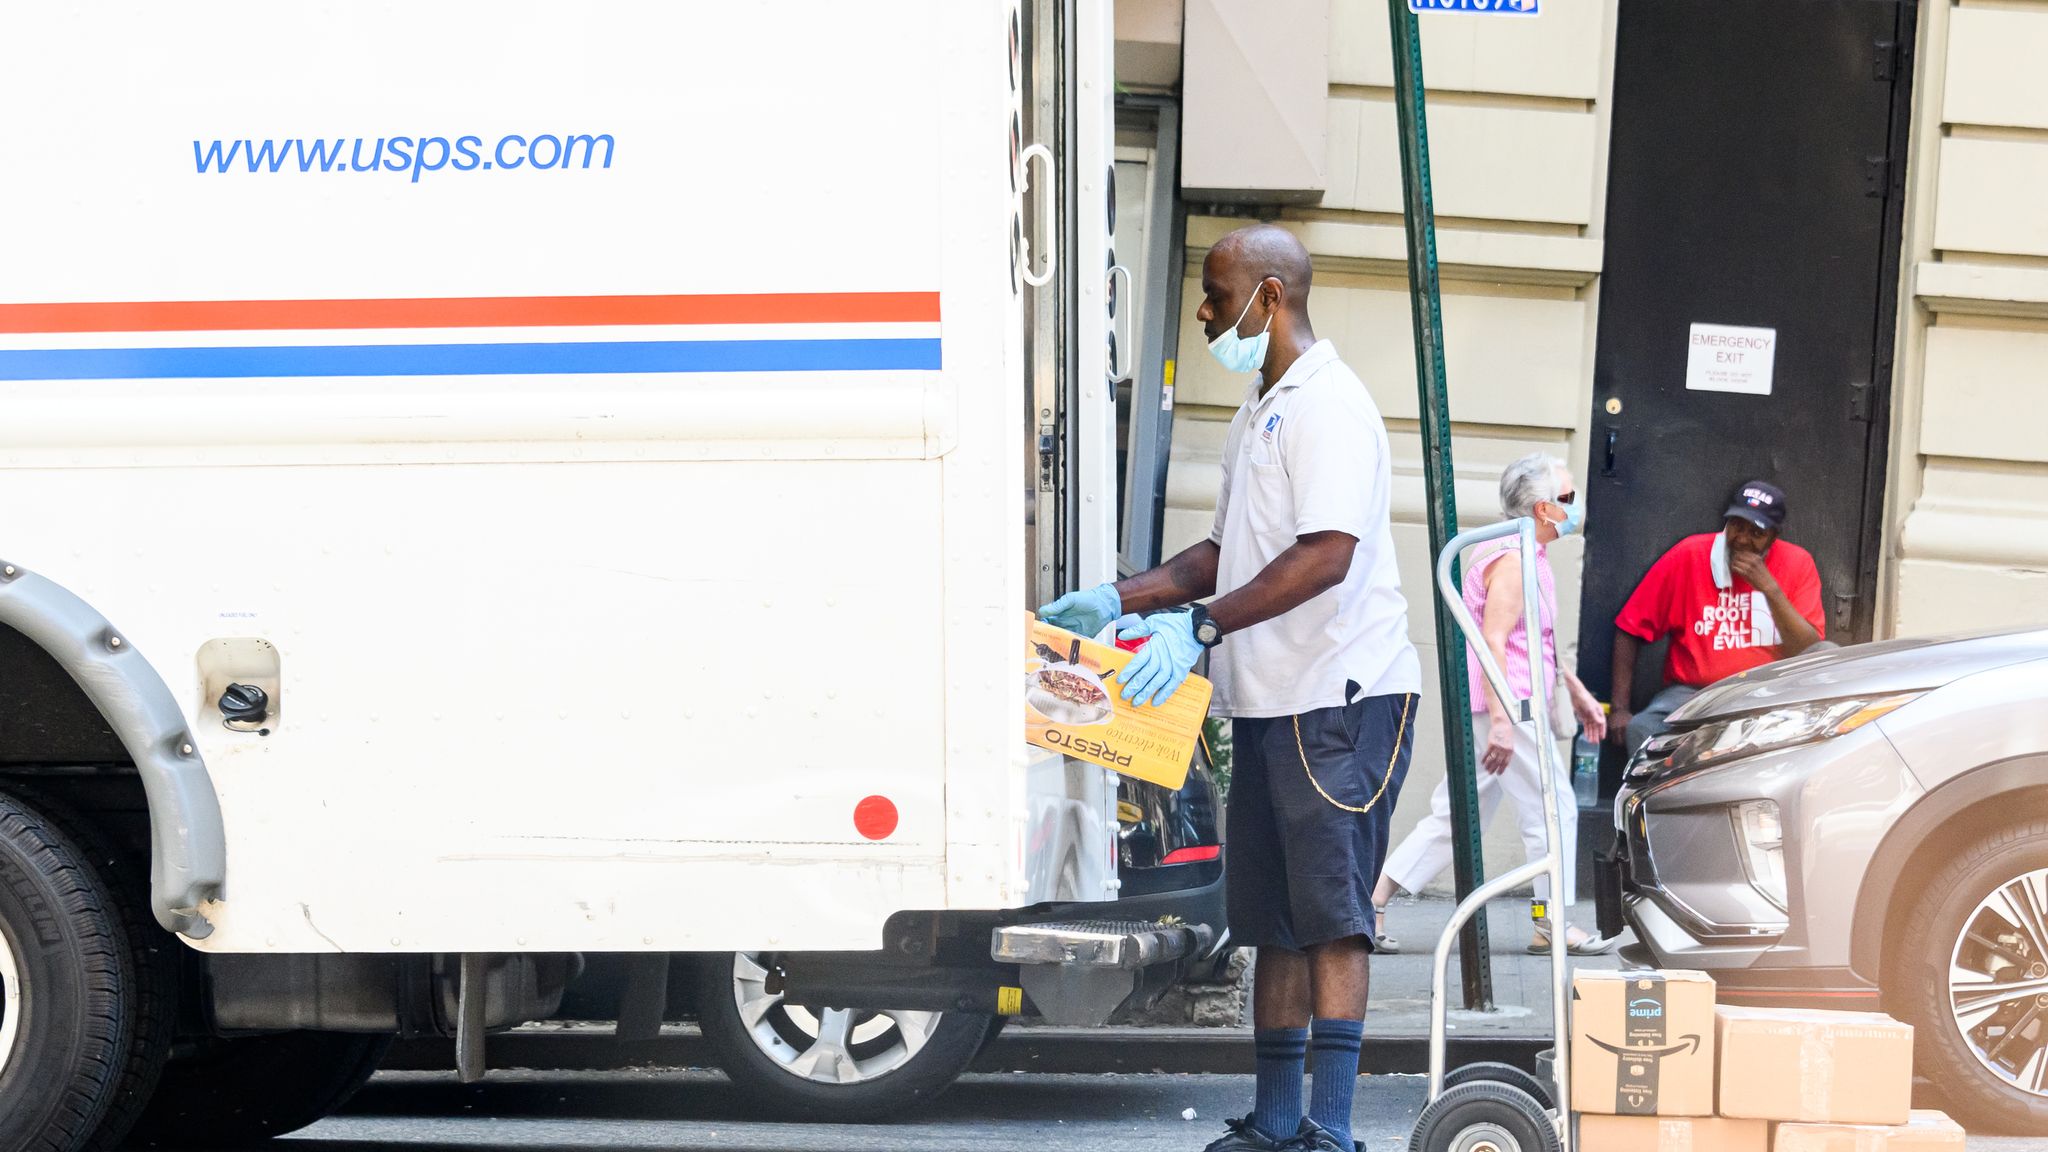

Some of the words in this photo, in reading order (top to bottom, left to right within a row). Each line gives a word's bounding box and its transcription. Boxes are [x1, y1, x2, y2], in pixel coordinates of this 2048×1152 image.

[192, 133, 616, 184] www.usps.com
[1692, 334, 1771, 350] EMERGENCY
[1716, 351, 1745, 364] EXIT
[1718, 592, 1750, 607] THE
[1702, 605, 1750, 622] ROOT
[1694, 621, 1715, 636] OF
[1718, 622, 1750, 636] ALL
[1713, 635, 1751, 650] EVIL
[1045, 729, 1133, 767] PRESTO
[1157, 743, 1181, 762] Wok
[1629, 1007, 1662, 1019] prime
